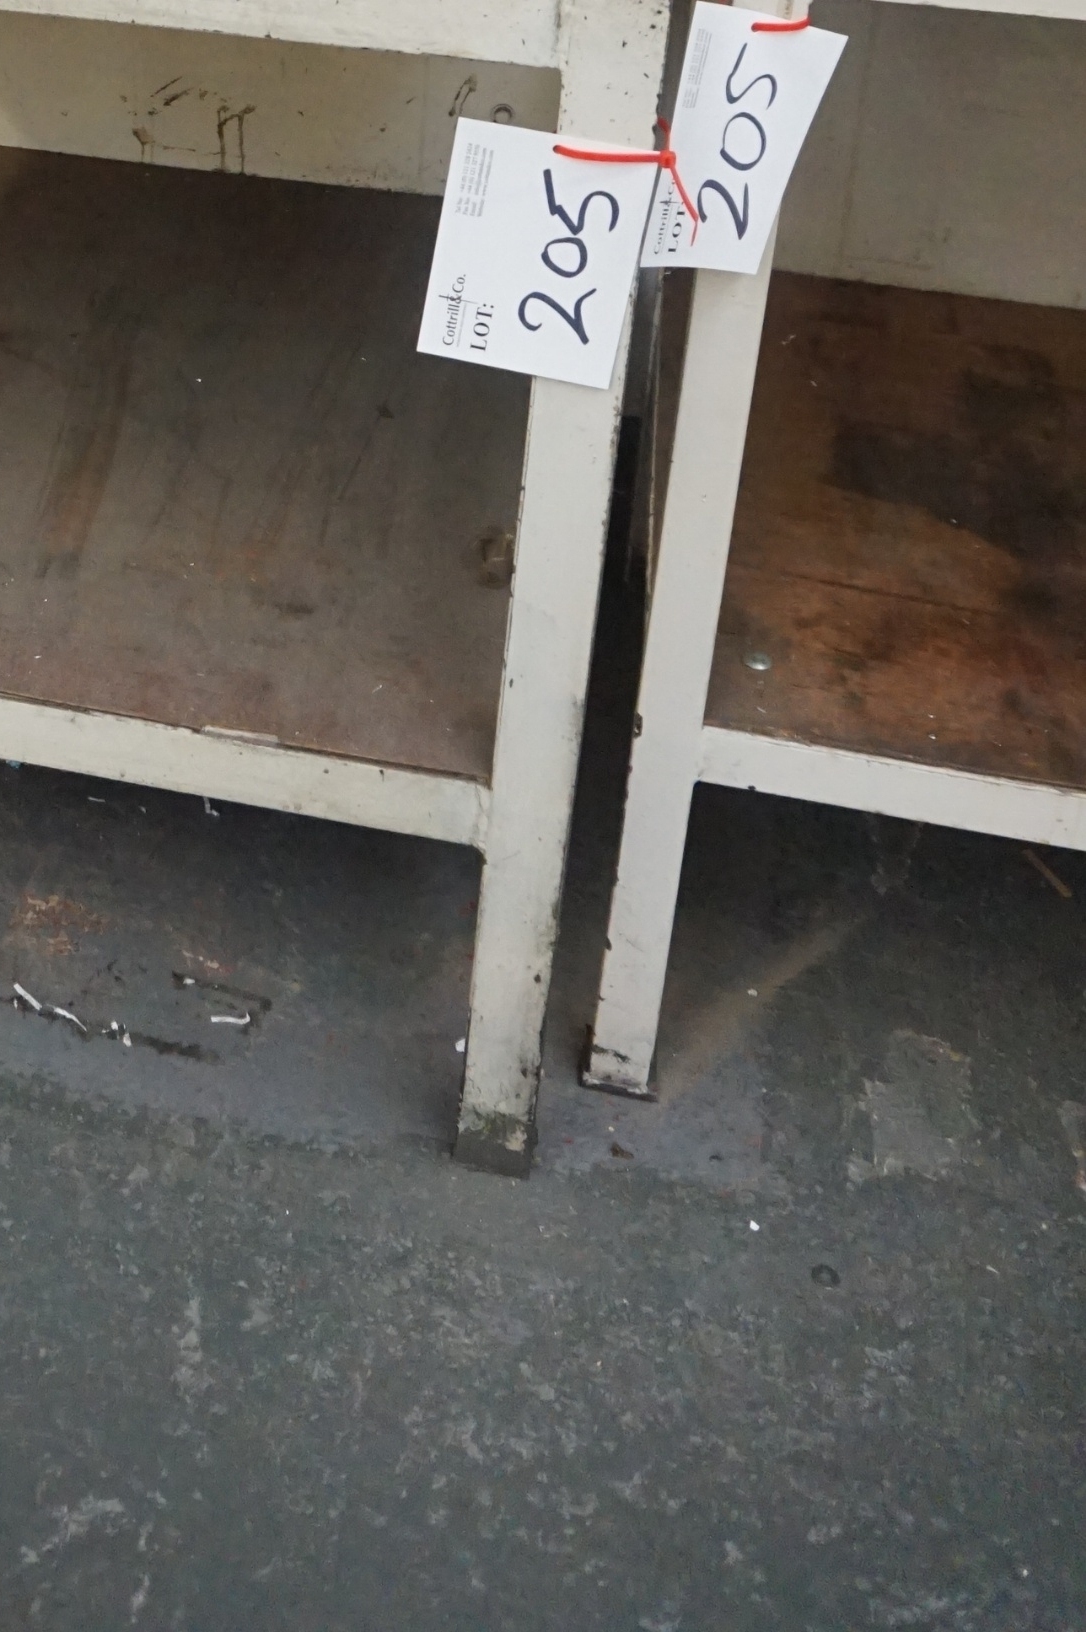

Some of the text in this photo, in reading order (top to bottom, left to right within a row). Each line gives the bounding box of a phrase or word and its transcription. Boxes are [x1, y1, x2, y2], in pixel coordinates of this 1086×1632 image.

[697, 42, 778, 240] 205
[470, 302, 495, 353] LOT:
[517, 168, 620, 346] 205
